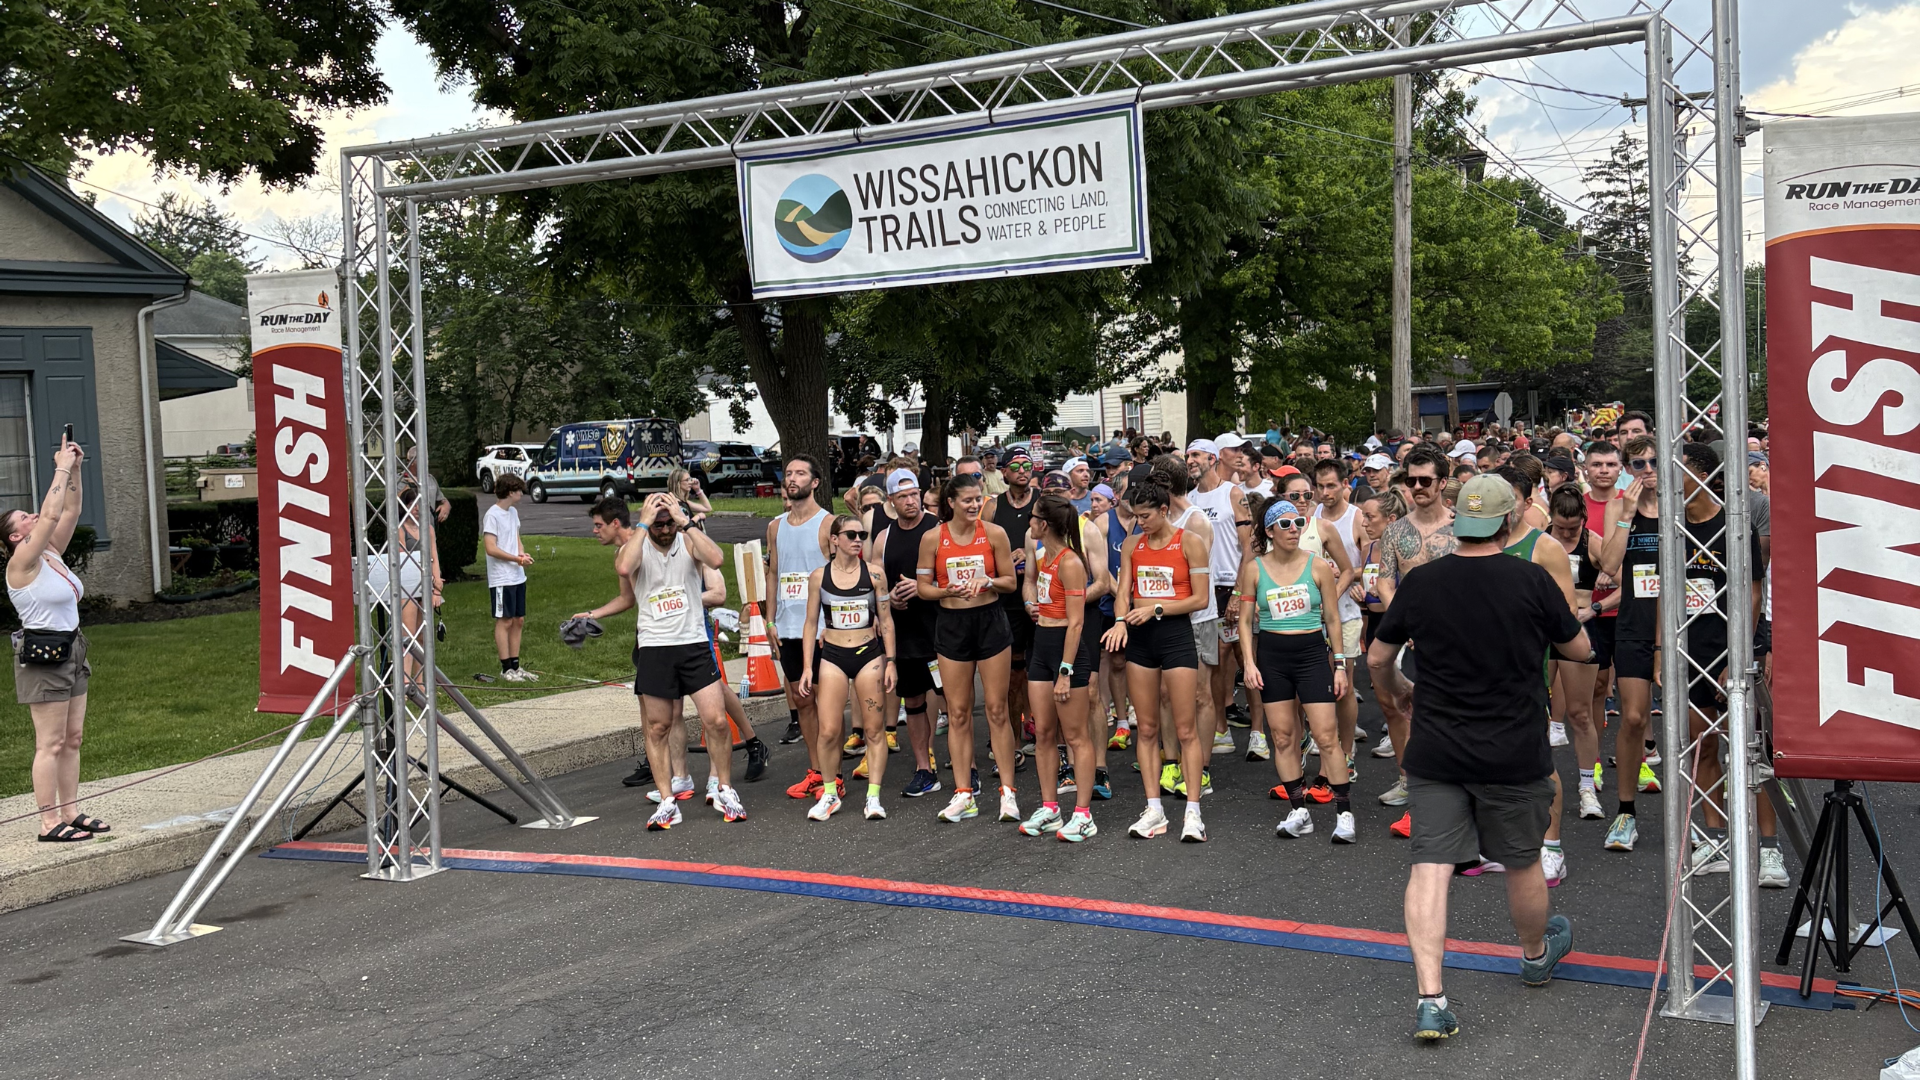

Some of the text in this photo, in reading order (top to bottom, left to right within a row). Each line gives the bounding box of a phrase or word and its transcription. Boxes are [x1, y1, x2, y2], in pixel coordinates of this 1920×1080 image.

[853, 141, 1103, 211] WISSAHICKON
[1785, 177, 1920, 200] RUN THE DA
[984, 190, 1109, 220] CONNECTING LAND,
[1808, 197, 1920, 211] Race Managemen
[858, 205, 982, 254] TRAILS
[986, 213, 1107, 241] WATER & PEOPLE
[260, 312, 331, 326] RUN THE DAY
[285, 325, 321, 334] Management
[576, 428, 600, 442] VMSC
[645, 443, 671, 453] VMSC
[502, 466, 522, 477] VMSC
[1807, 255, 1920, 729] FINISH
[272, 363, 336, 679] FINISH
[956, 568, 976, 580] 837
[786, 584, 802, 595] 447
[1142, 579, 1170, 591] 1286
[657, 598, 683, 613] 1066
[1275, 598, 1305, 613] 1238
[840, 612, 860, 624] 710
